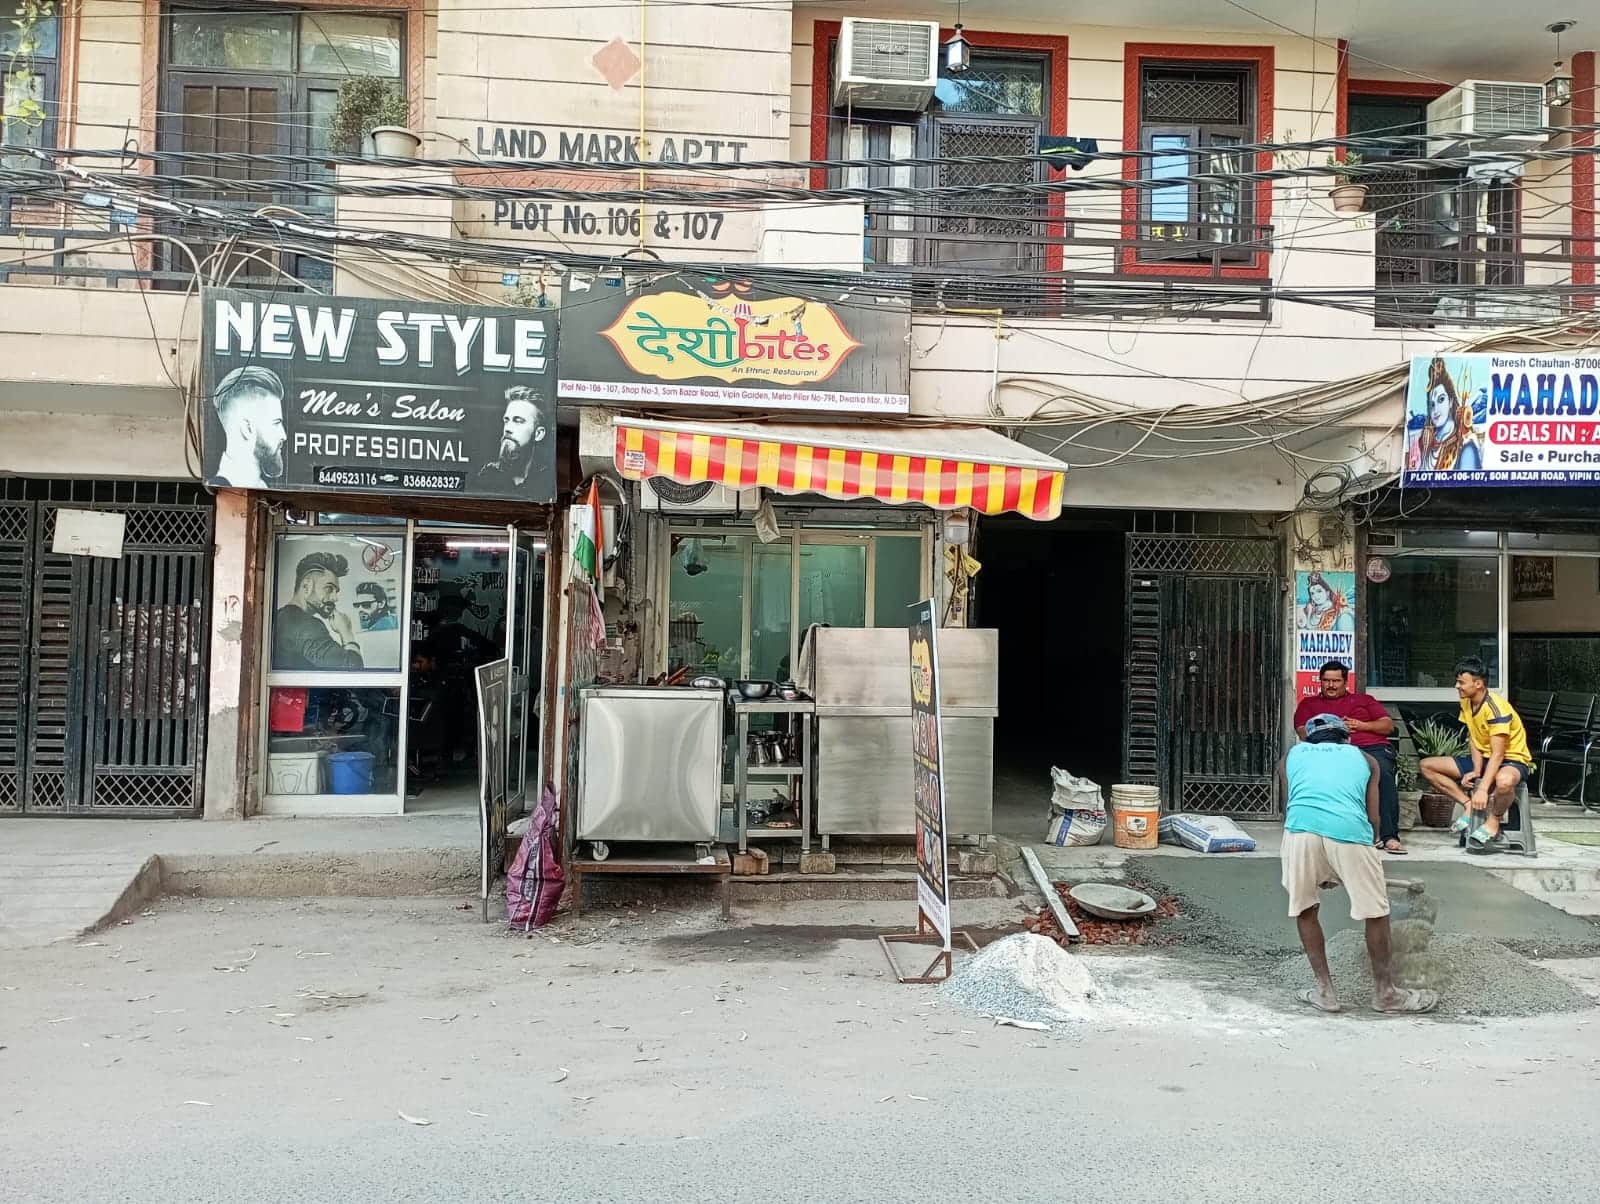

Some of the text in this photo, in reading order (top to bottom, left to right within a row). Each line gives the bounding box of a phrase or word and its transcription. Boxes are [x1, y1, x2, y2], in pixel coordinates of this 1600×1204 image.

[477, 126, 748, 163] LAND MARK APTT
[494, 200, 724, 240] PLOT No. 106 & 107
[214, 299, 548, 376] NEW STYLE
[734, 304, 831, 361] bites
[732, 366, 818, 377] An Ethnic Restaurant
[1491, 358, 1526, 368] Naresh
[622, 385, 639, 395] Shop
[680, 387, 699, 397] Bazar
[722, 389, 740, 400] Vipin
[1489, 373, 1600, 416] MAHAD
[300, 388, 466, 422] Men's Salon
[1496, 424, 1550, 442] DEALS
[1556, 424, 1576, 442] IN
[294, 432, 469, 463] PROFESSIONAL
[1500, 450, 1600, 463] Sale Purcha
[318, 471, 460, 489] 8449523116 8368628327
[1410, 472, 1433, 481] PLOT
[1489, 472, 1508, 481] SOM
[1510, 472, 1539, 481] BAZAR
[1541, 471, 1567, 482] ROAD,
[1569, 471, 1592, 481] VIPIN
[1300, 633, 1353, 653] MAHADEV
[1302, 686, 1316, 696] ALL
